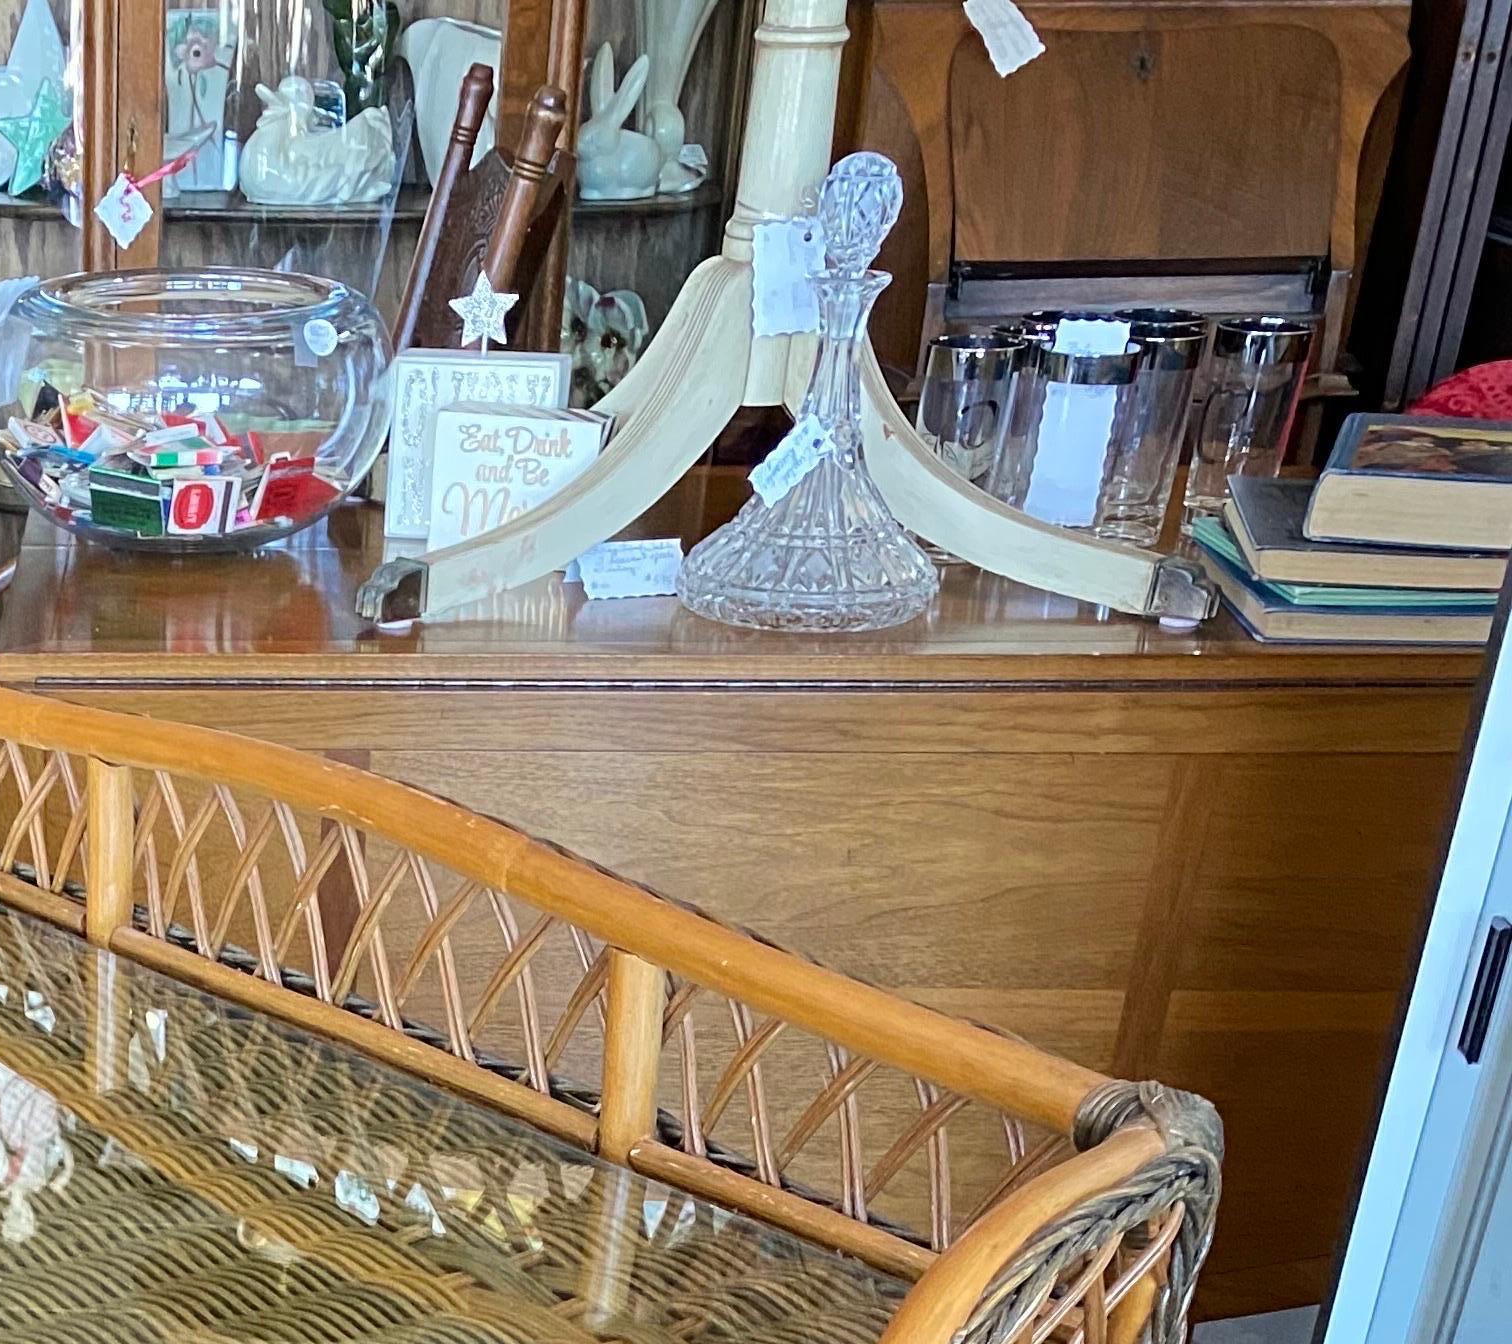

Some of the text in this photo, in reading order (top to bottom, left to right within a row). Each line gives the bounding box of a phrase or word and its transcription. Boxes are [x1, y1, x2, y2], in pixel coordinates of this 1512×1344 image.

[459, 424, 573, 458] Eat, Drink
[475, 454, 550, 486] and Be
